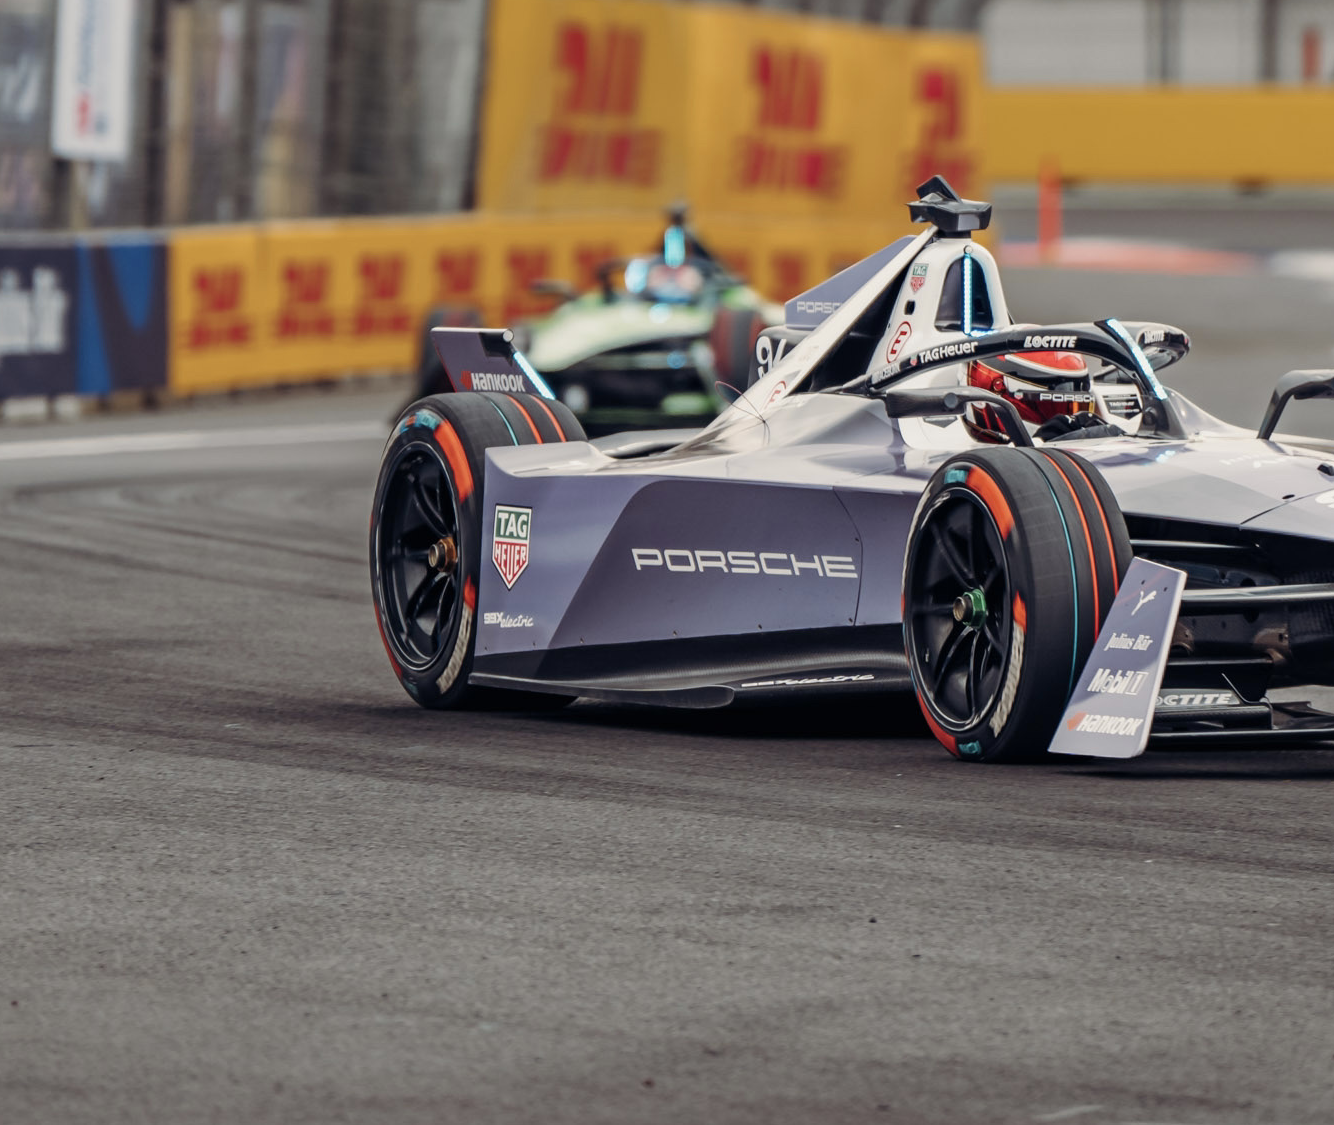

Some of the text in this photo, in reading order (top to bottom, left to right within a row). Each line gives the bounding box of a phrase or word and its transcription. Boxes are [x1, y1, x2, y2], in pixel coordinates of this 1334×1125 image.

[1024, 335, 1078, 348] LOCTITE
[496, 511, 528, 538] TAG
[494, 543, 529, 583] HEUER
[631, 548, 858, 578] PORSCHE
[1103, 632, 1154, 651] Julius Bär
[1087, 667, 1134, 694] Mobil
[1155, 693, 1233, 706] OCTITE
